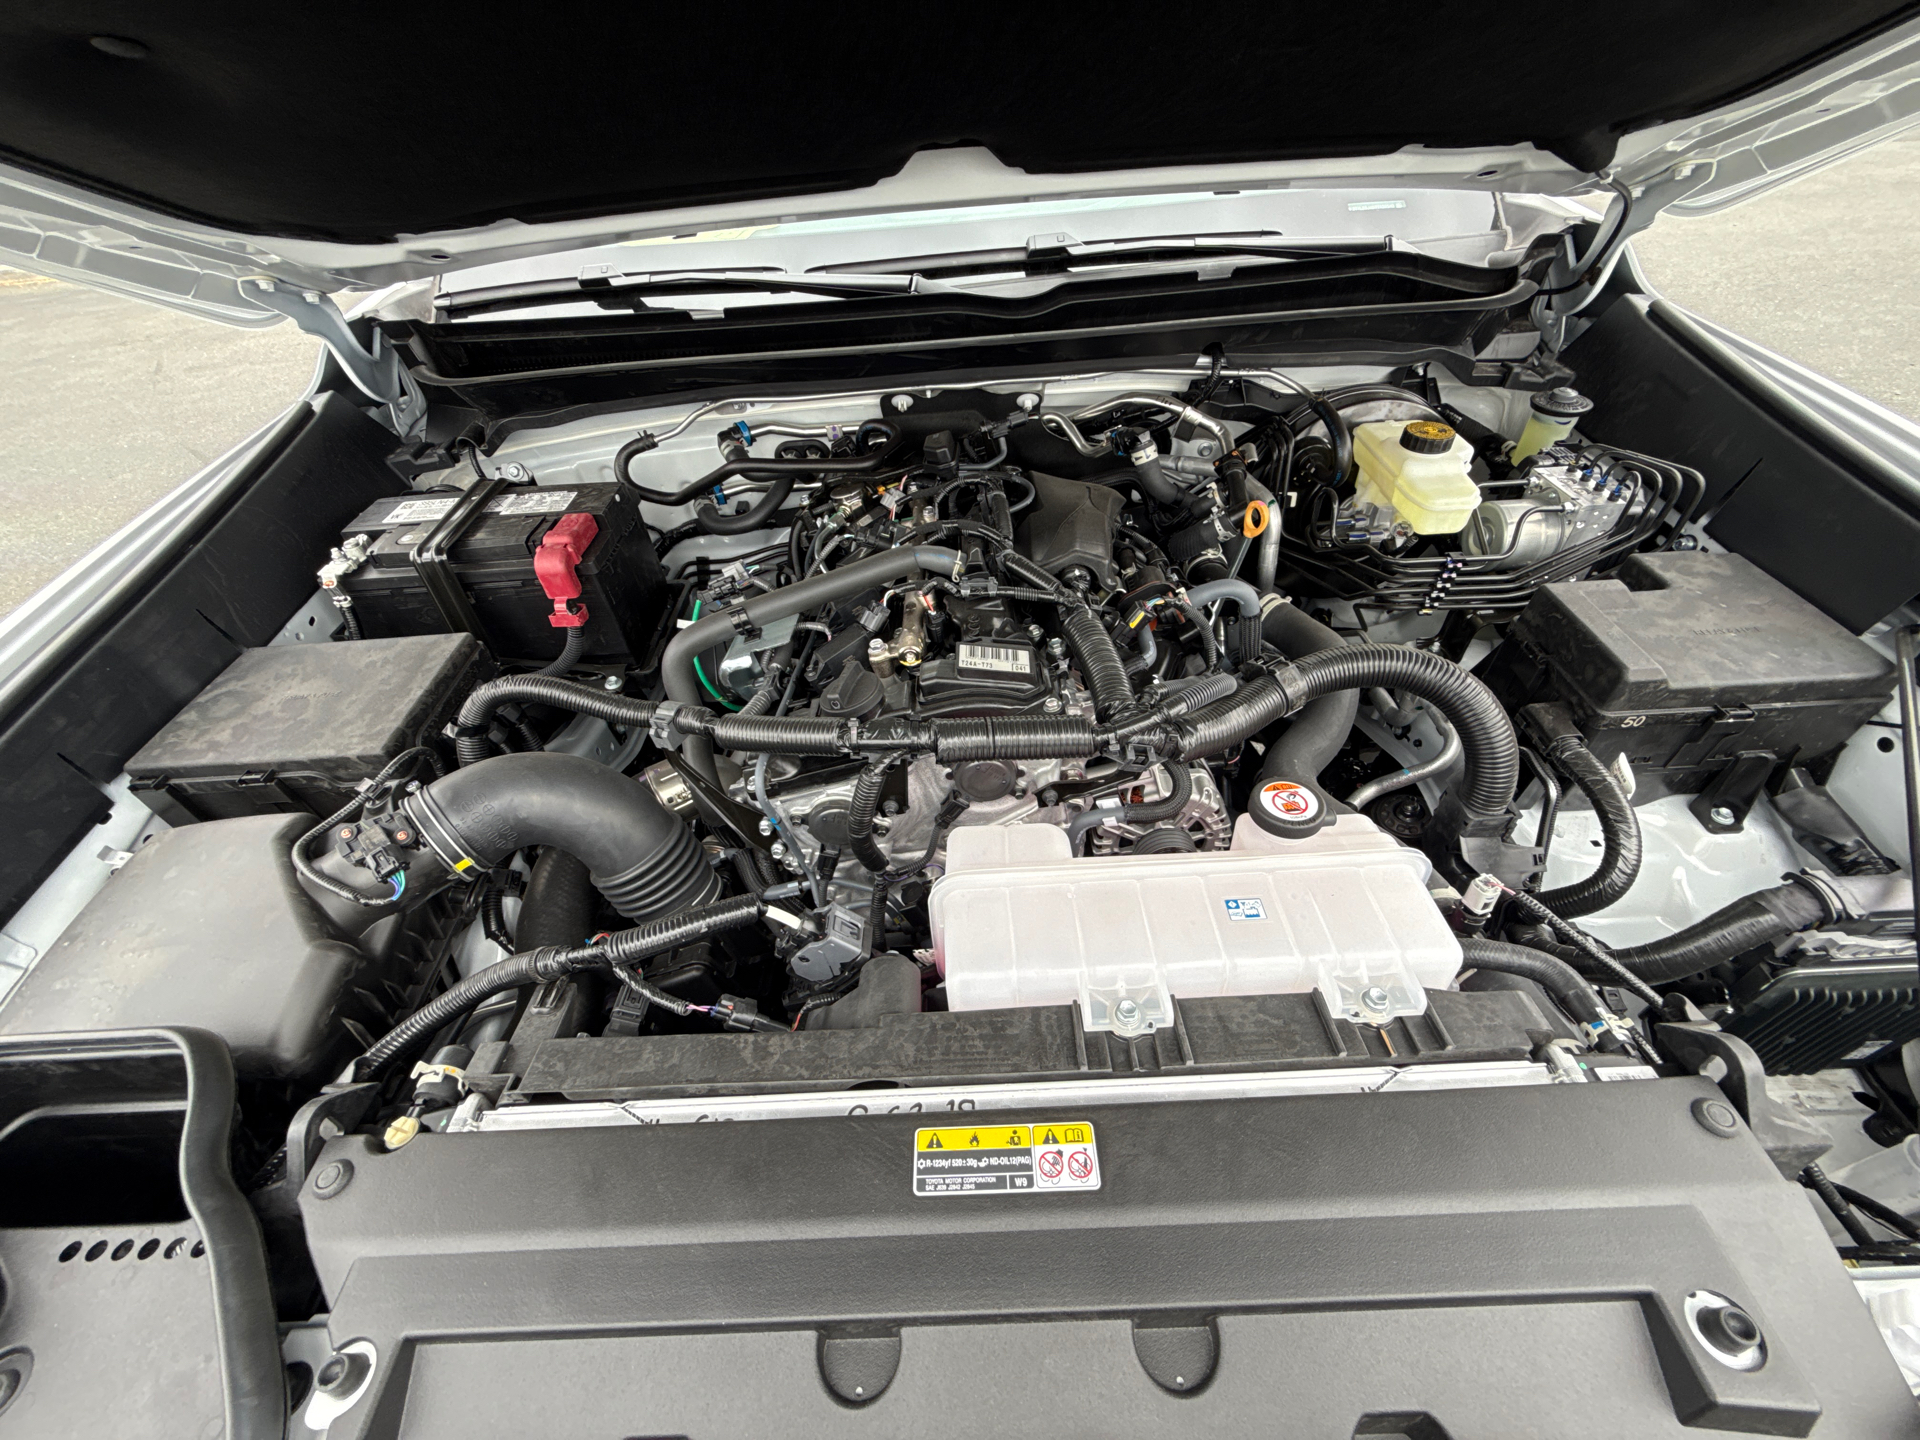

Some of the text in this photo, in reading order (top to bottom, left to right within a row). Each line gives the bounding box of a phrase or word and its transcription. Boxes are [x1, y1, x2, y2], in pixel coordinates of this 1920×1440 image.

[1621, 715, 1646, 728] 50
[926, 1155, 1032, 1169] R-1234yf 520±30g ND-OIL12(PAG)
[963, 1176, 997, 1184] CORPORATION
[1014, 1177, 1028, 1187] W9
